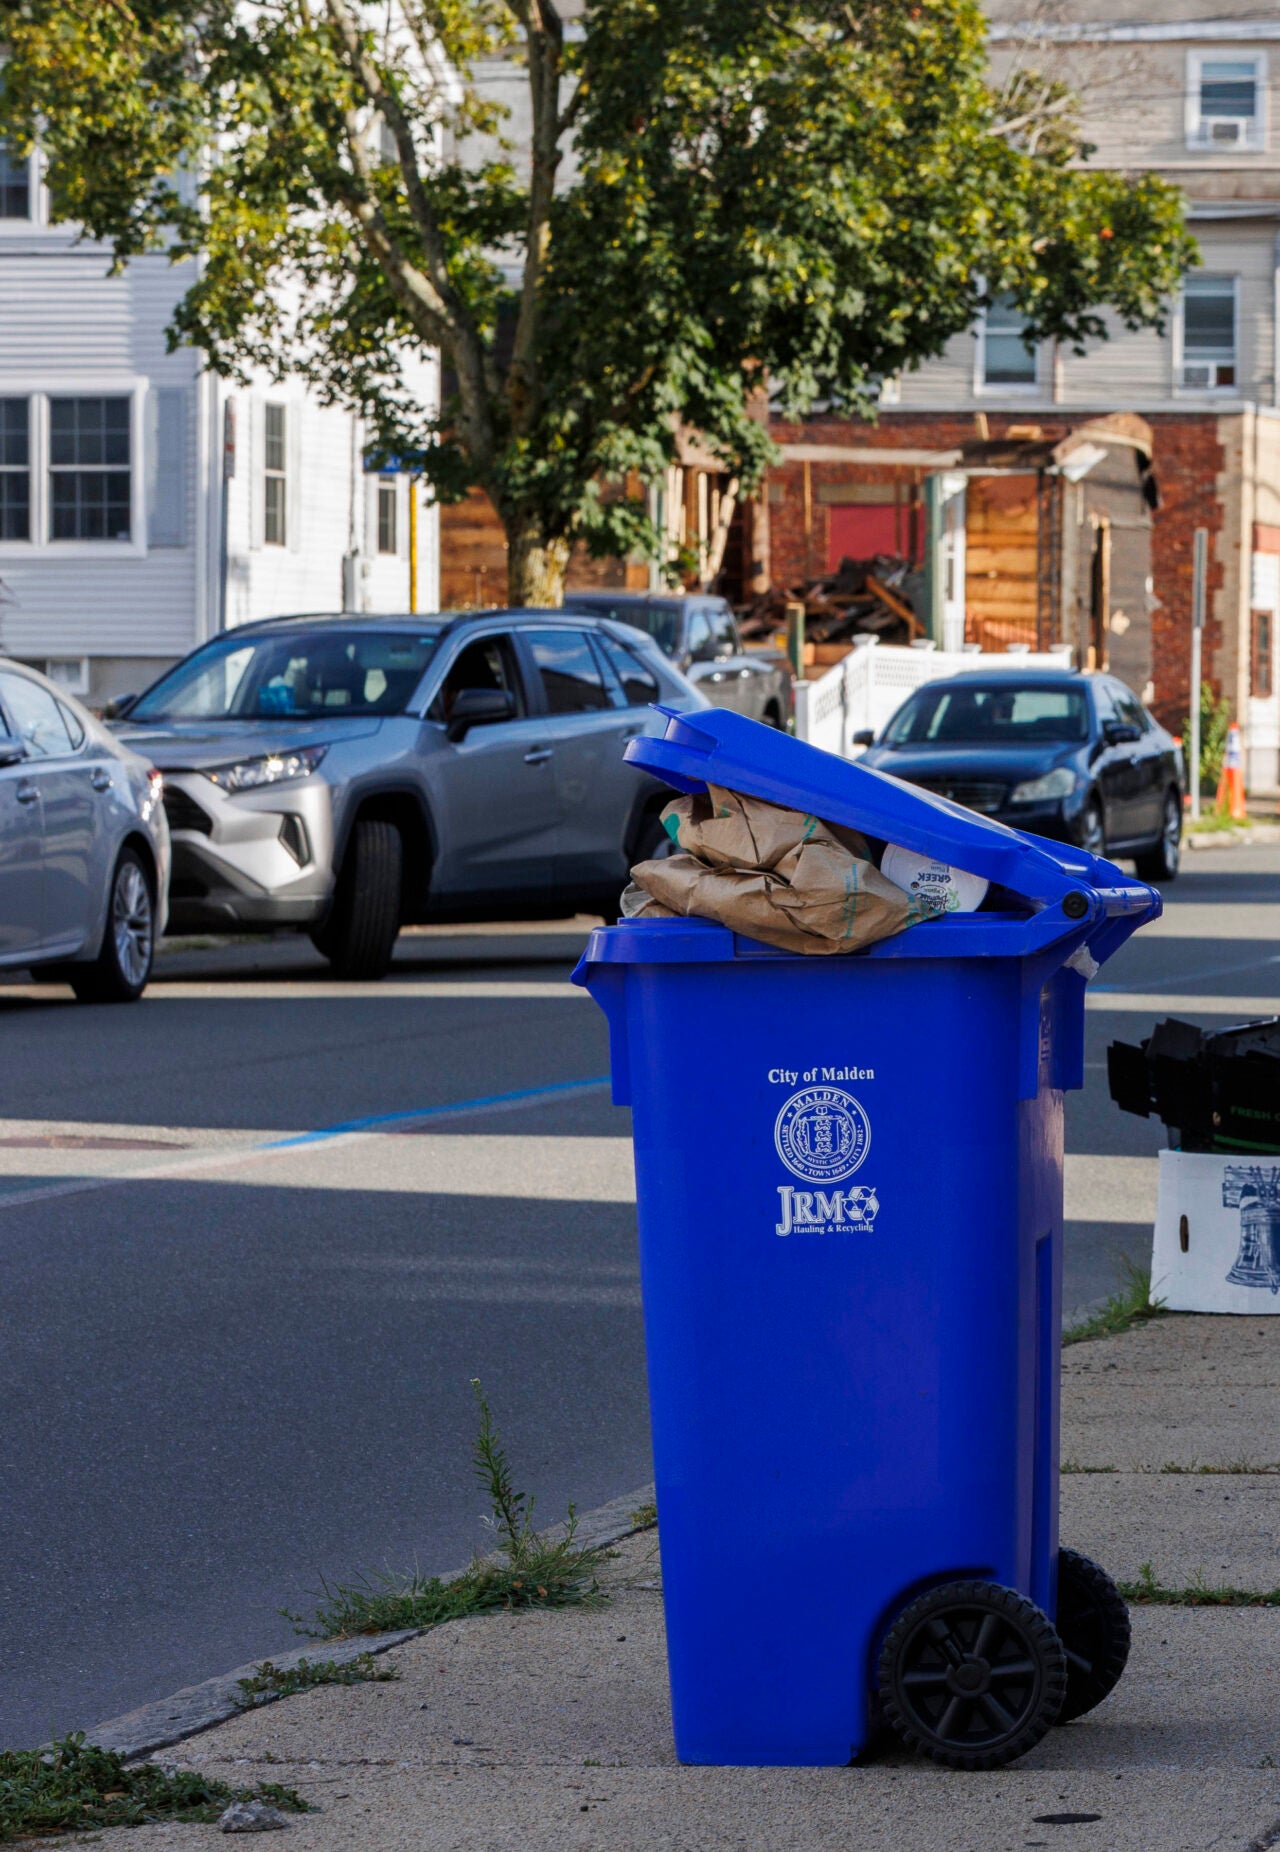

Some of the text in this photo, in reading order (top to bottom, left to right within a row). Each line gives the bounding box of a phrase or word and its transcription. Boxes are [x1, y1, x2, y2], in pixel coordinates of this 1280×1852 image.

[917, 873, 952, 884] GREEK
[767, 1066, 875, 1086] City of Malden
[792, 1091, 851, 1111] MALDEN
[1230, 1105, 1272, 1120] FRESH
[781, 1124, 794, 1158] SETTLED
[807, 1168, 831, 1177] TOWN
[848, 1148, 862, 1164] CITY
[806, 1156, 828, 1165] MYSTIC
[775, 1185, 845, 1236] JRM
[793, 1222, 874, 1235] Hauling & Recycling
